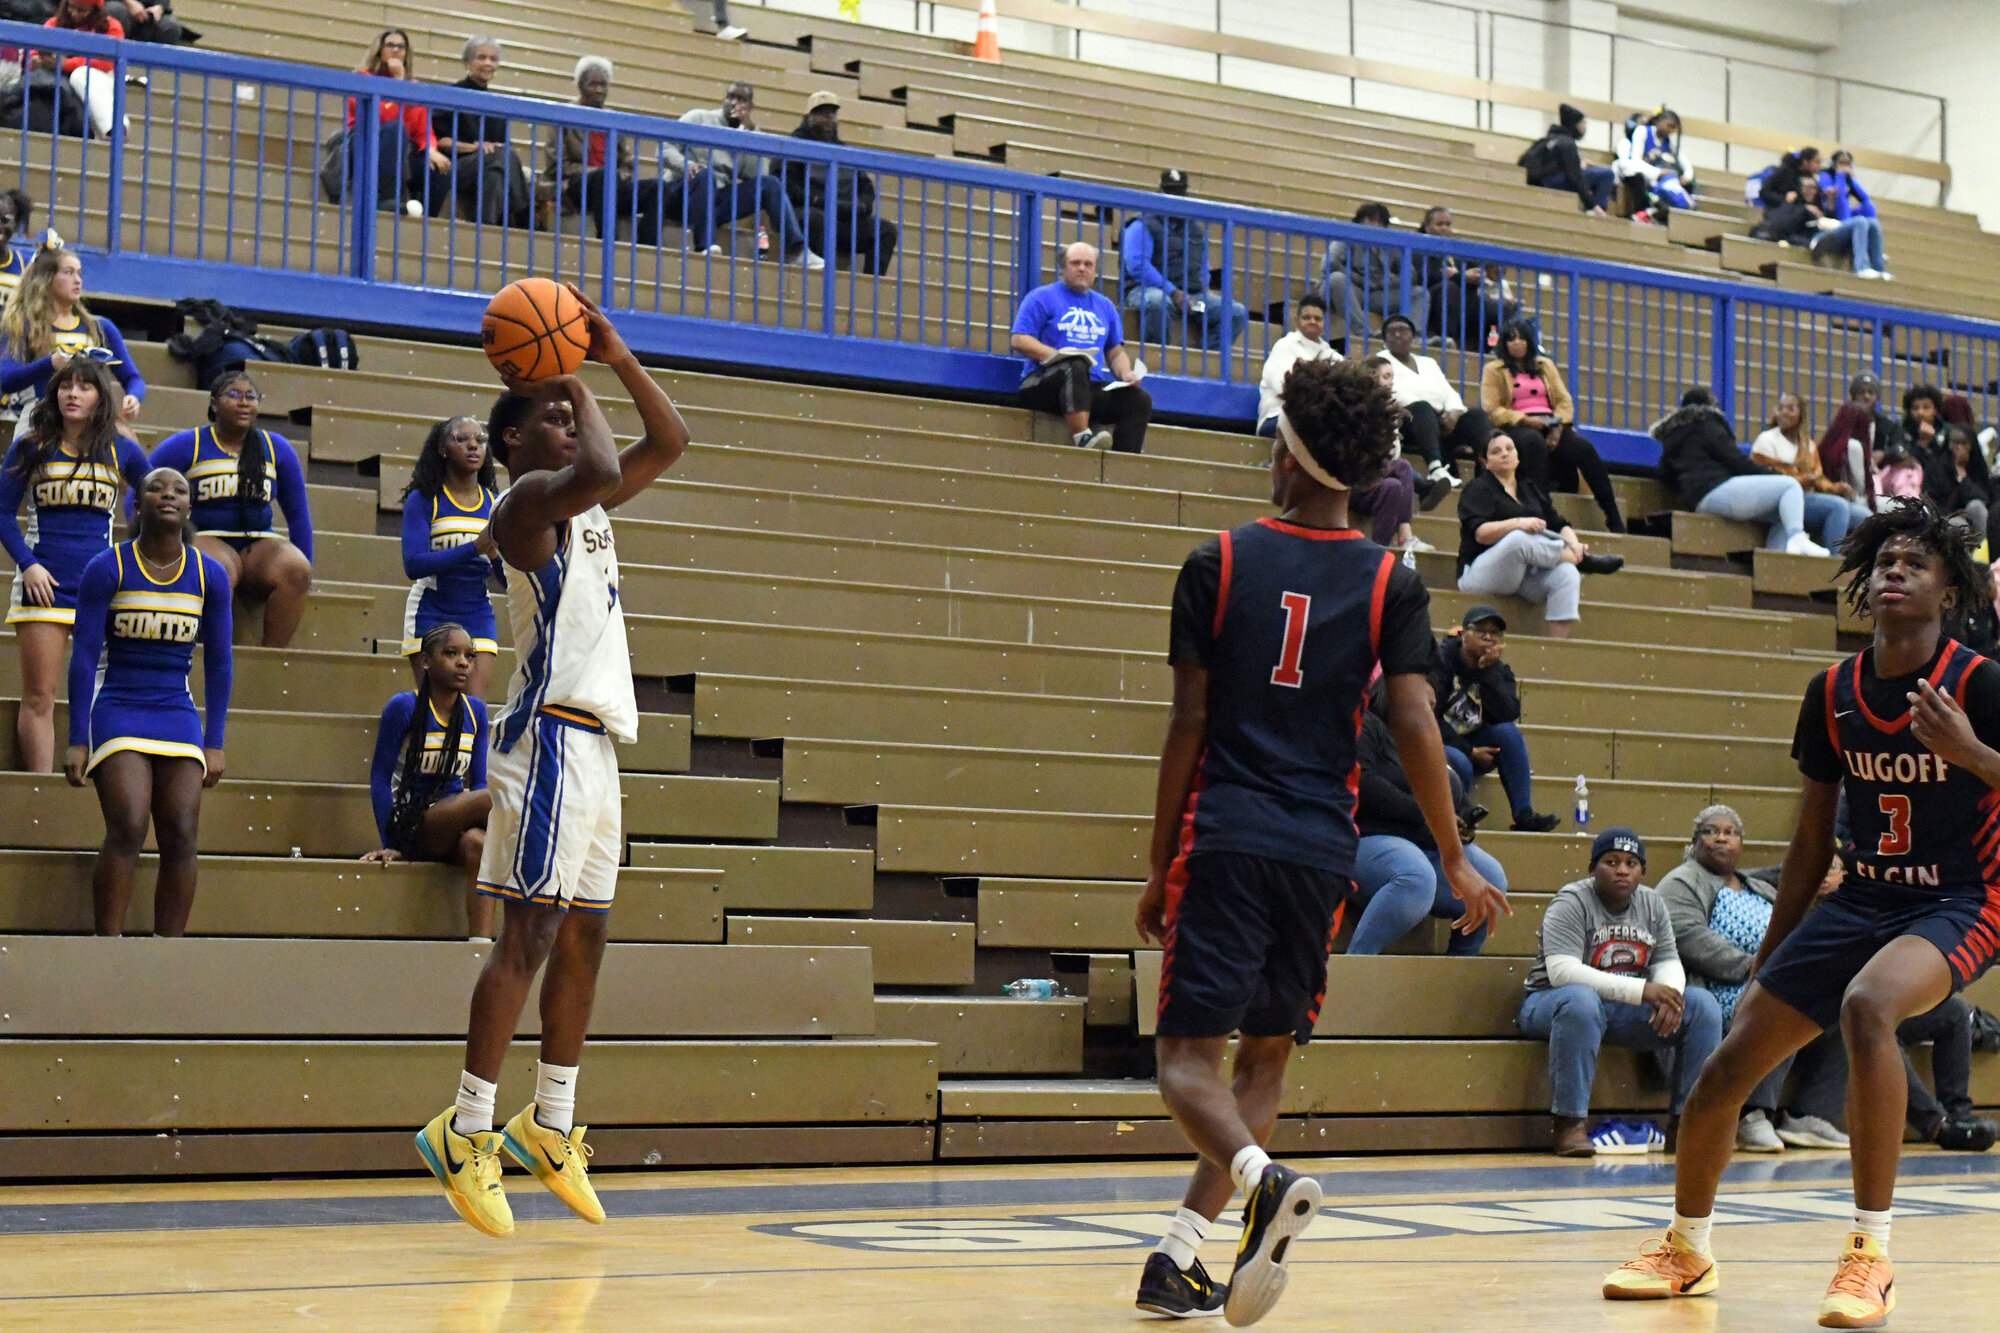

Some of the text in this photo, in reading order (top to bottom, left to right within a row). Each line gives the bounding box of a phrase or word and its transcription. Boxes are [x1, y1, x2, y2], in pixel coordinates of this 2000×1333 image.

[36, 479, 115, 509] SUMTER
[198, 473, 271, 501] SUMR
[113, 611, 199, 642] SUMTER
[1270, 590, 1312, 688] 1
[1844, 750, 1948, 783] LUGOFF
[1877, 793, 1911, 855] 3
